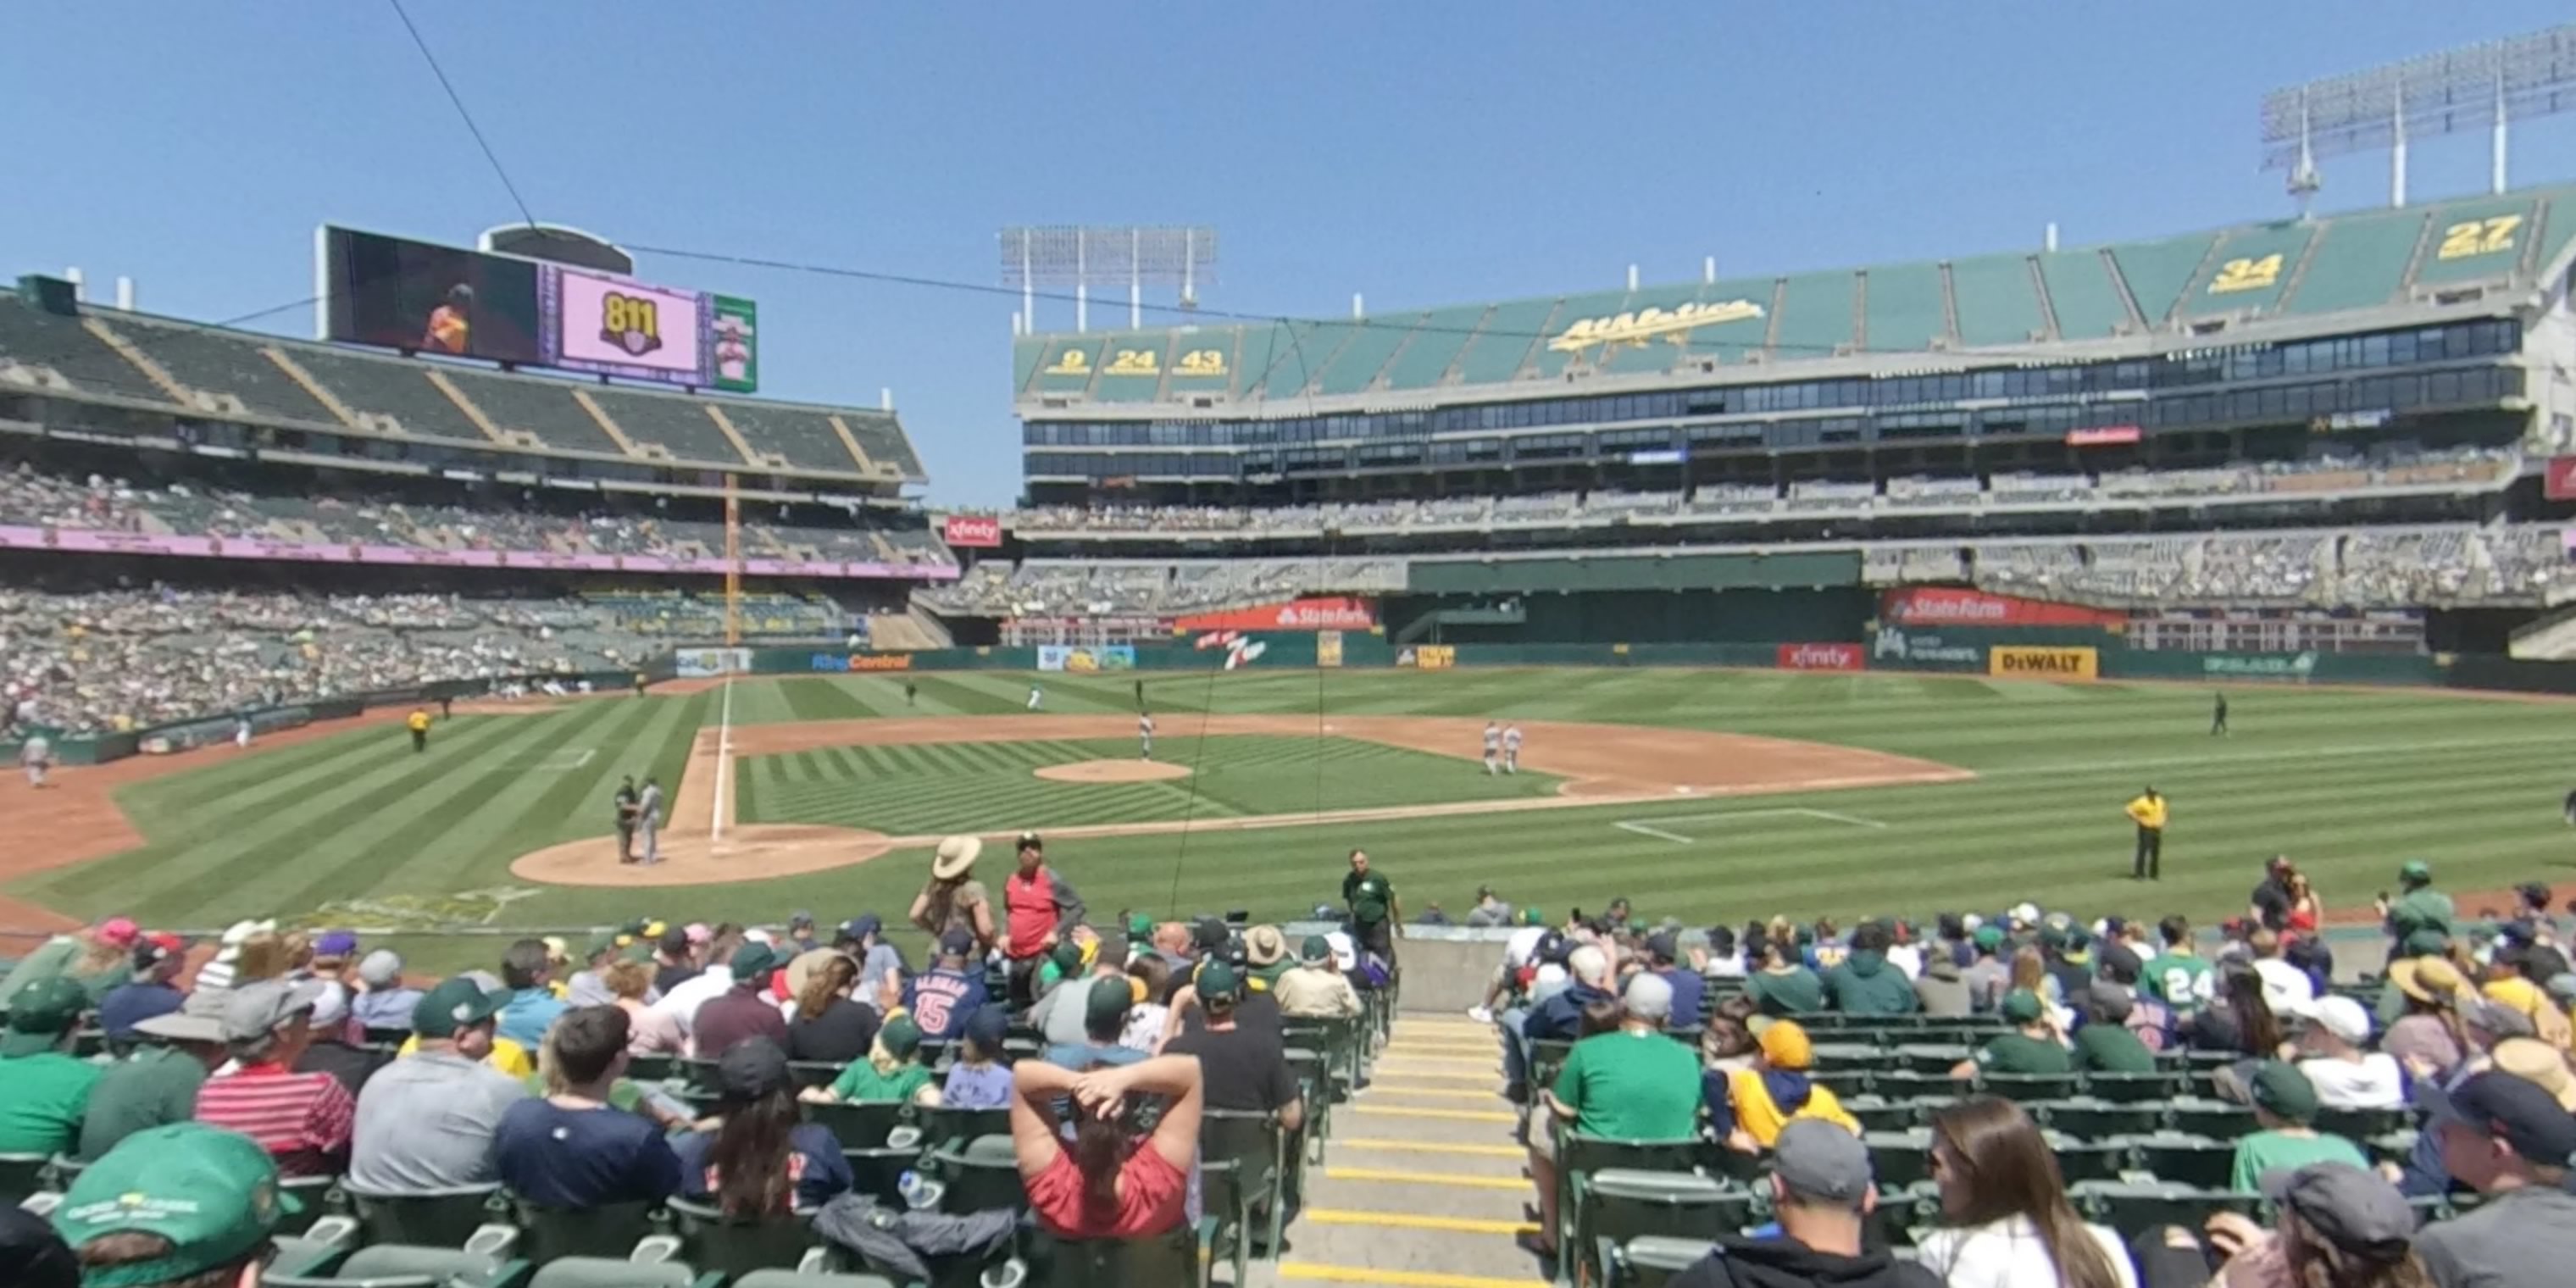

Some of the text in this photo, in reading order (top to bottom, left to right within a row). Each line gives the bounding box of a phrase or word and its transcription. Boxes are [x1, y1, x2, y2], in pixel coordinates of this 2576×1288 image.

[2441, 214, 2522, 252] 27
[605, 292, 656, 337] 811
[1062, 348, 1085, 367] 9
[1113, 350, 1156, 367] 24
[1181, 350, 1222, 367] 43
[949, 519, 996, 541] xfinity
[1790, 644, 1852, 668] xfinity
[2164, 967, 2213, 1003] 24
[914, 991, 955, 1033] 15
